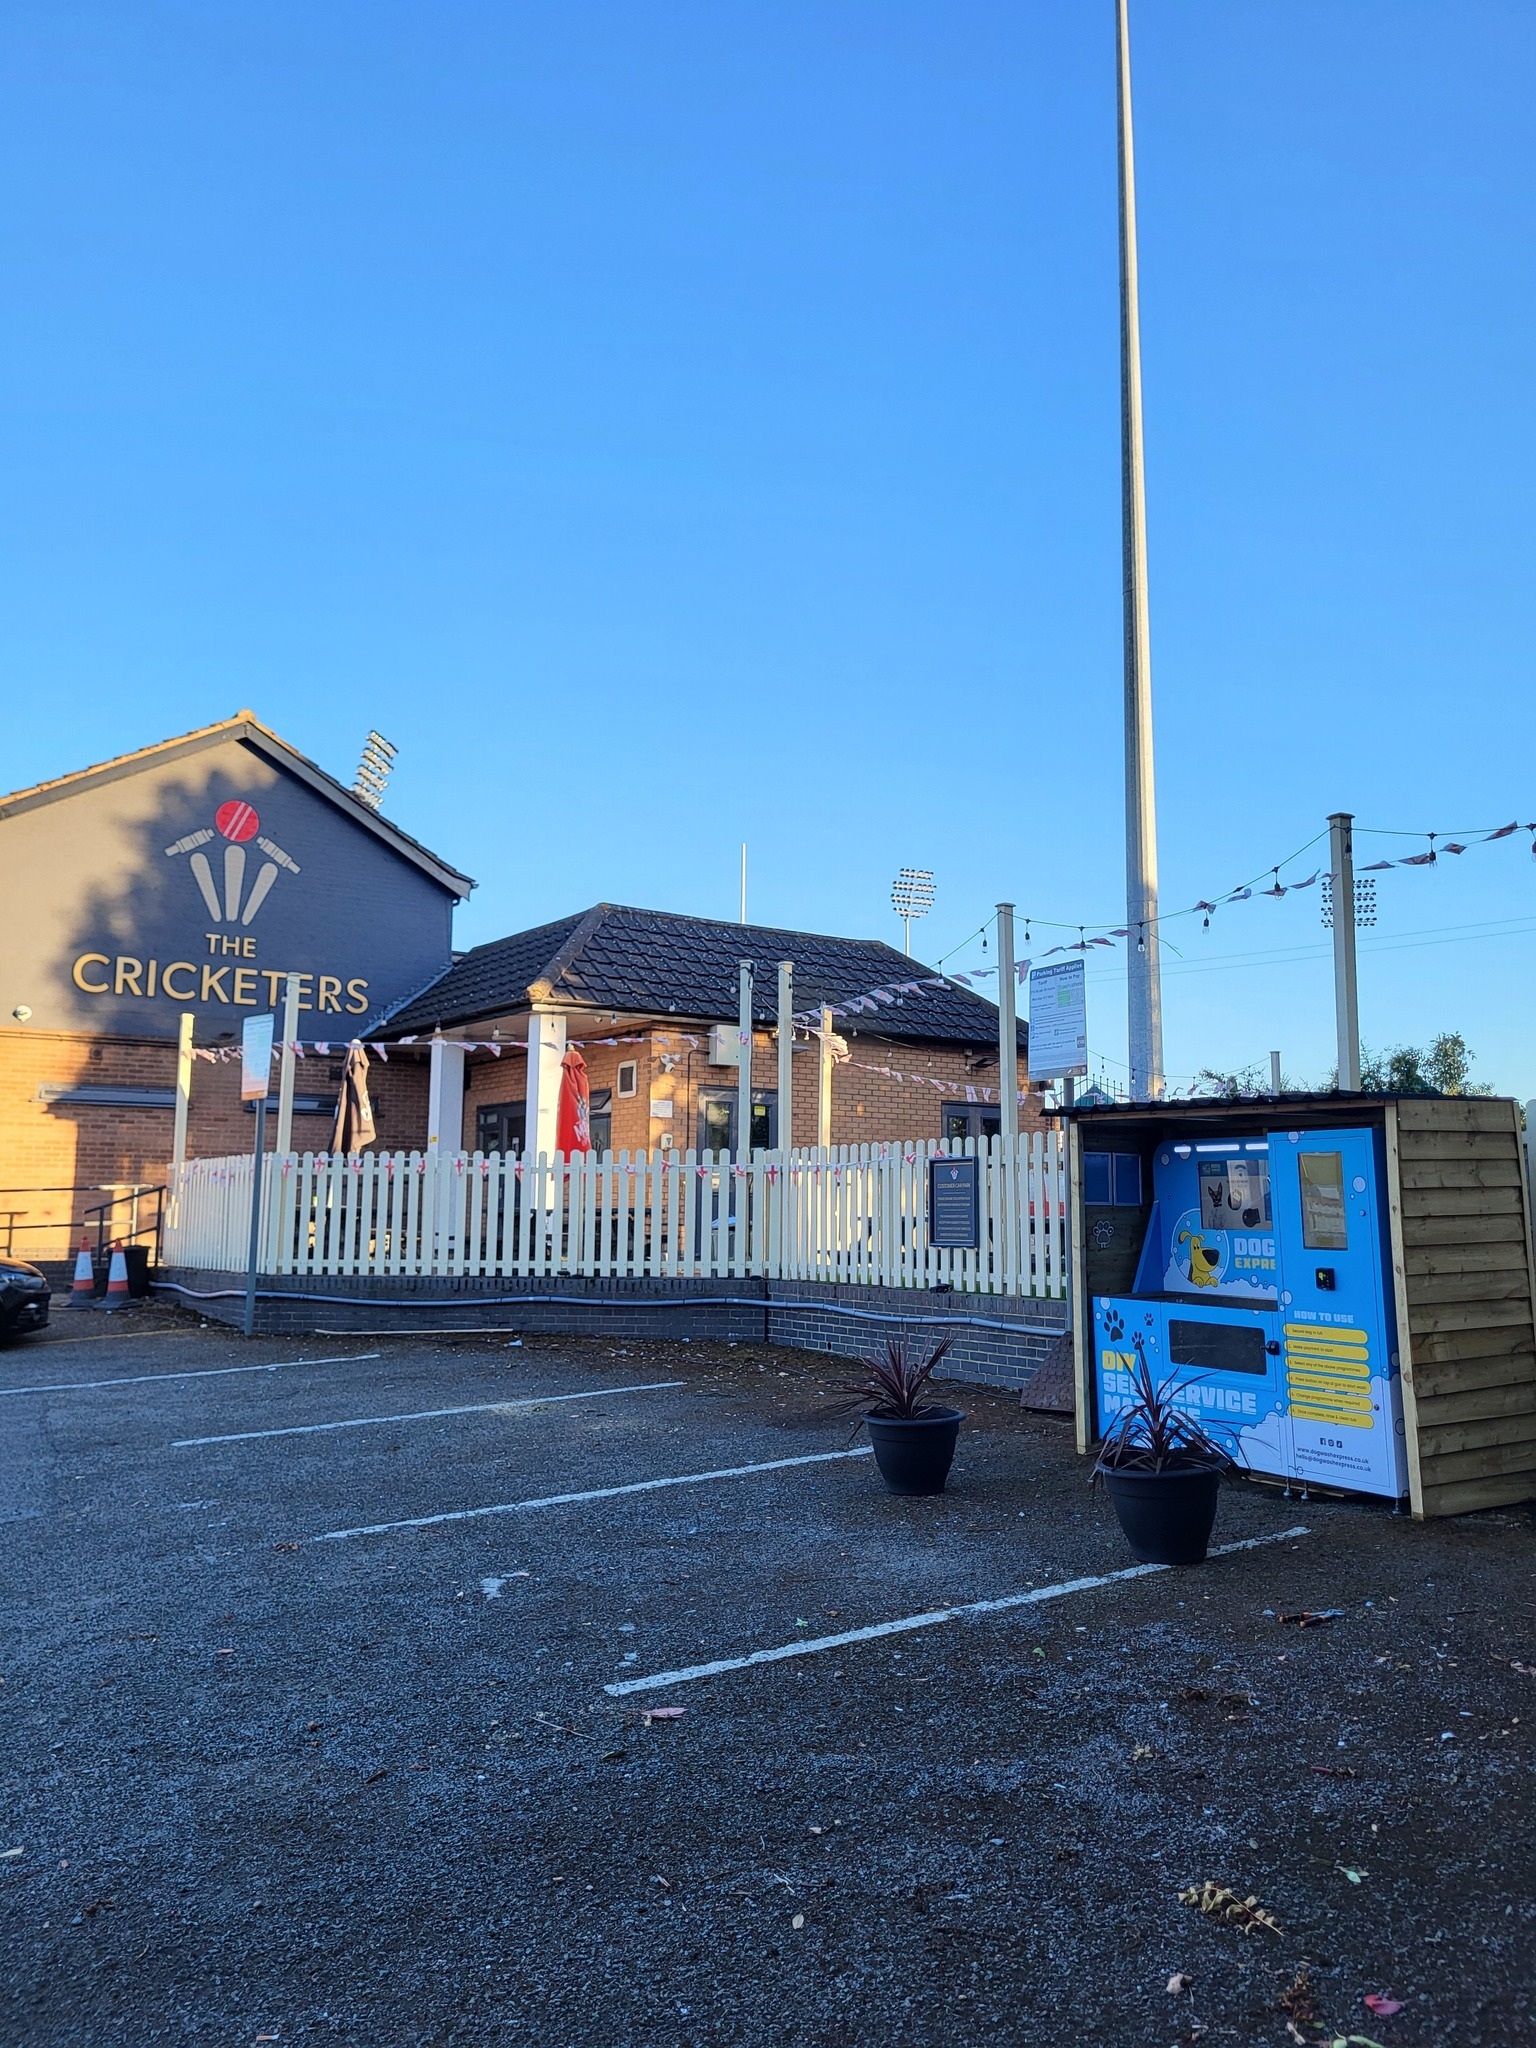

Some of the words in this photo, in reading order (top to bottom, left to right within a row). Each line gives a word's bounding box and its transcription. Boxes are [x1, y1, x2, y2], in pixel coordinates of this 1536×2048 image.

[205, 933, 257, 958] THE
[1036, 969, 1053, 977] Parking
[1053, 966, 1065, 974] Tariff
[1066, 963, 1083, 972] Applies
[72, 953, 369, 1015] CRICKETERS
[1234, 1238, 1276, 1257] DOG
[1294, 1310, 1317, 1320] HOW
[1318, 1312, 1332, 1322] TO
[1333, 1313, 1354, 1324] USE
[1102, 1350, 1138, 1372] DIY
[1157, 1380, 1257, 1415] SERVICE
[1311, 1395, 1333, 1403] programme
[1296, 1447, 1369, 1464] www.dogwashexpress.co.uk
[1296, 1453, 1372, 1472] hello@dogwashexpress.co.uk
